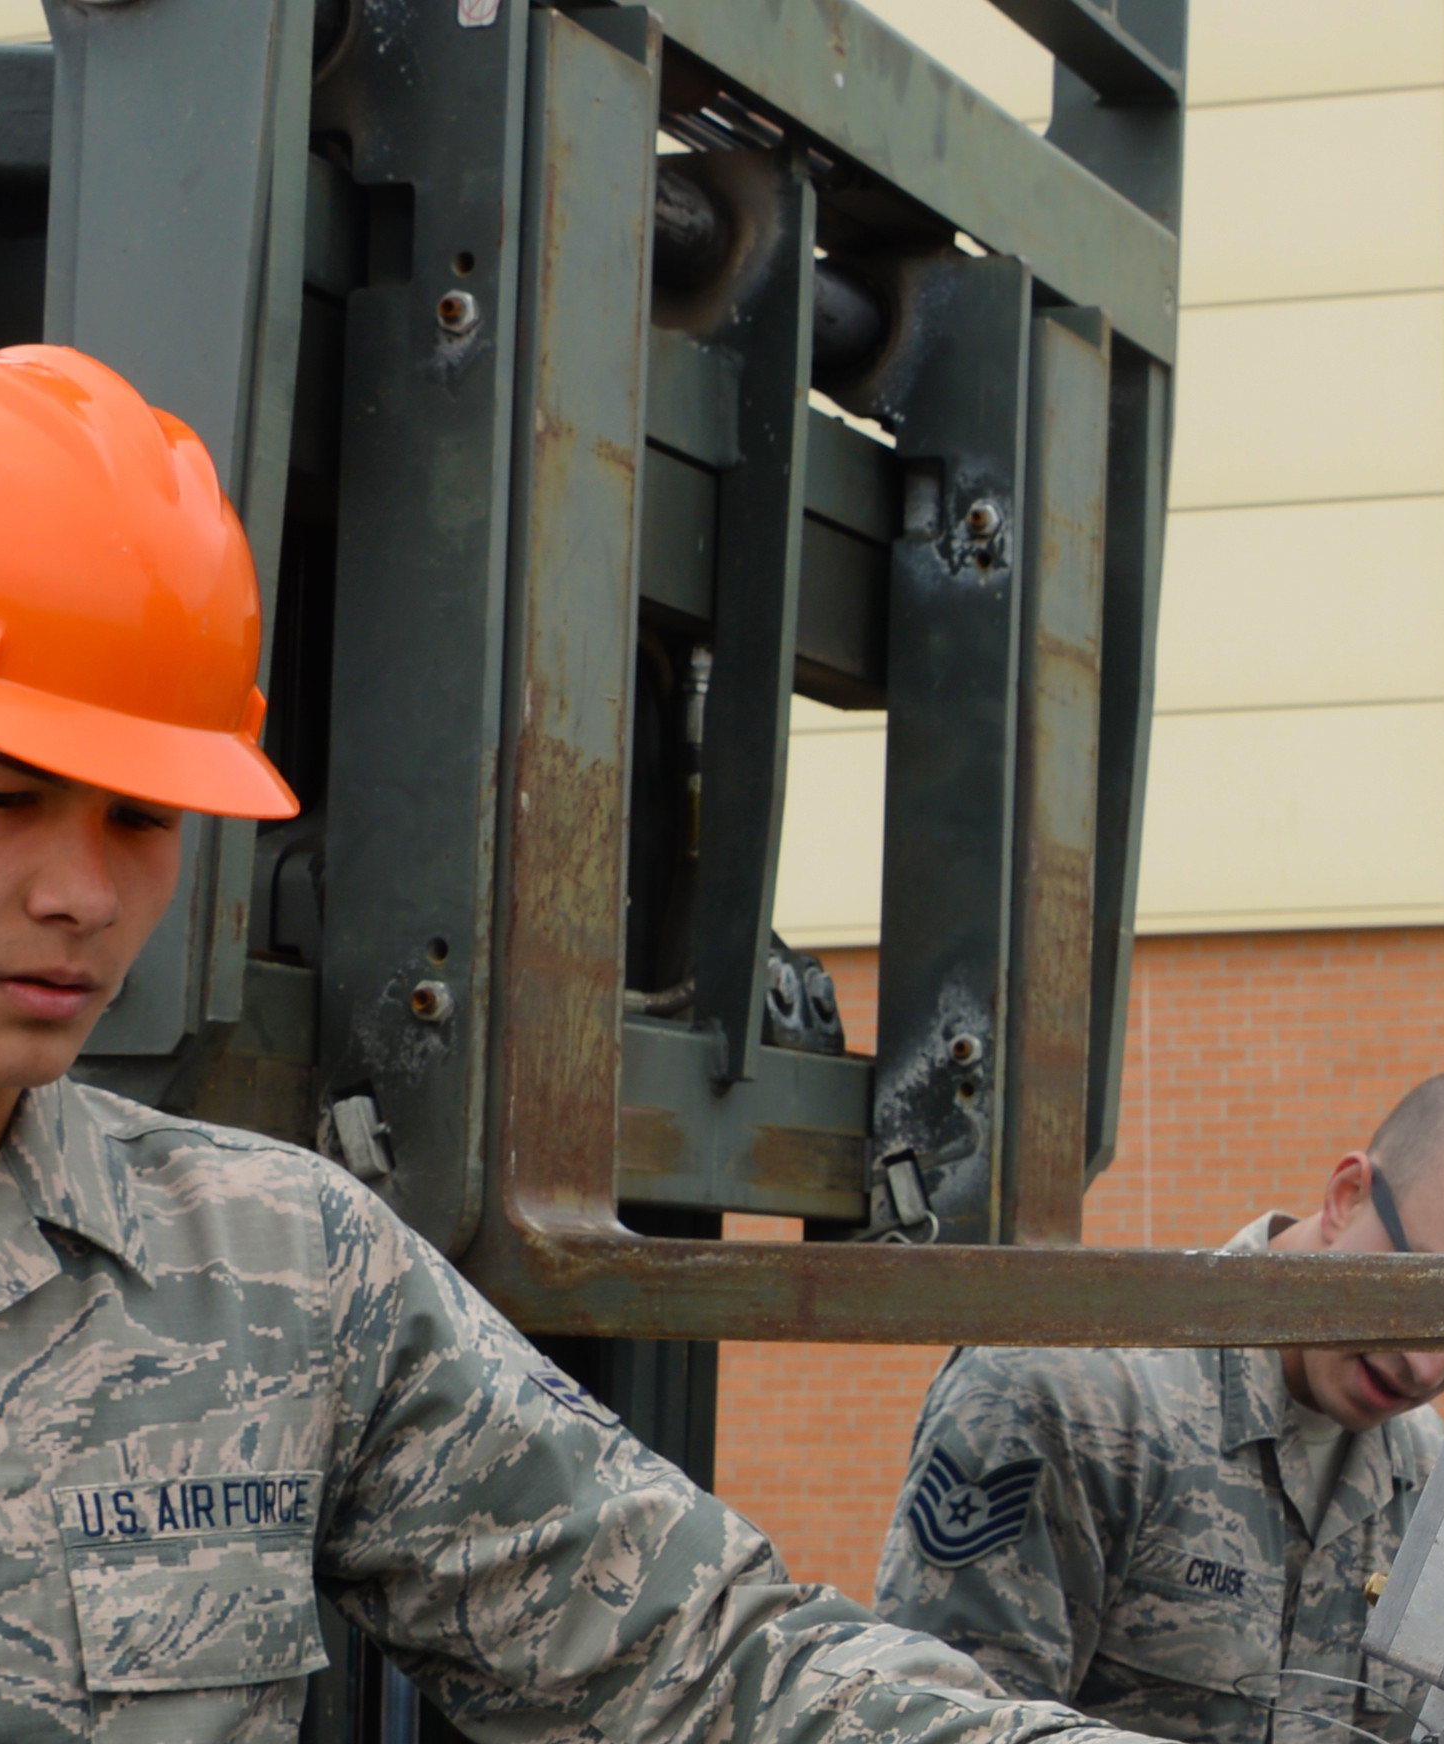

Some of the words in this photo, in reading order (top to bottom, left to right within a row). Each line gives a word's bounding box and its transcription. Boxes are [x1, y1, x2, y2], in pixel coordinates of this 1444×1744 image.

[77, 1490, 147, 1538] U.S.
[157, 1484, 216, 1531] AIR
[223, 1480, 310, 1526] FORCE
[1186, 1558, 1247, 1598] CRUSE
